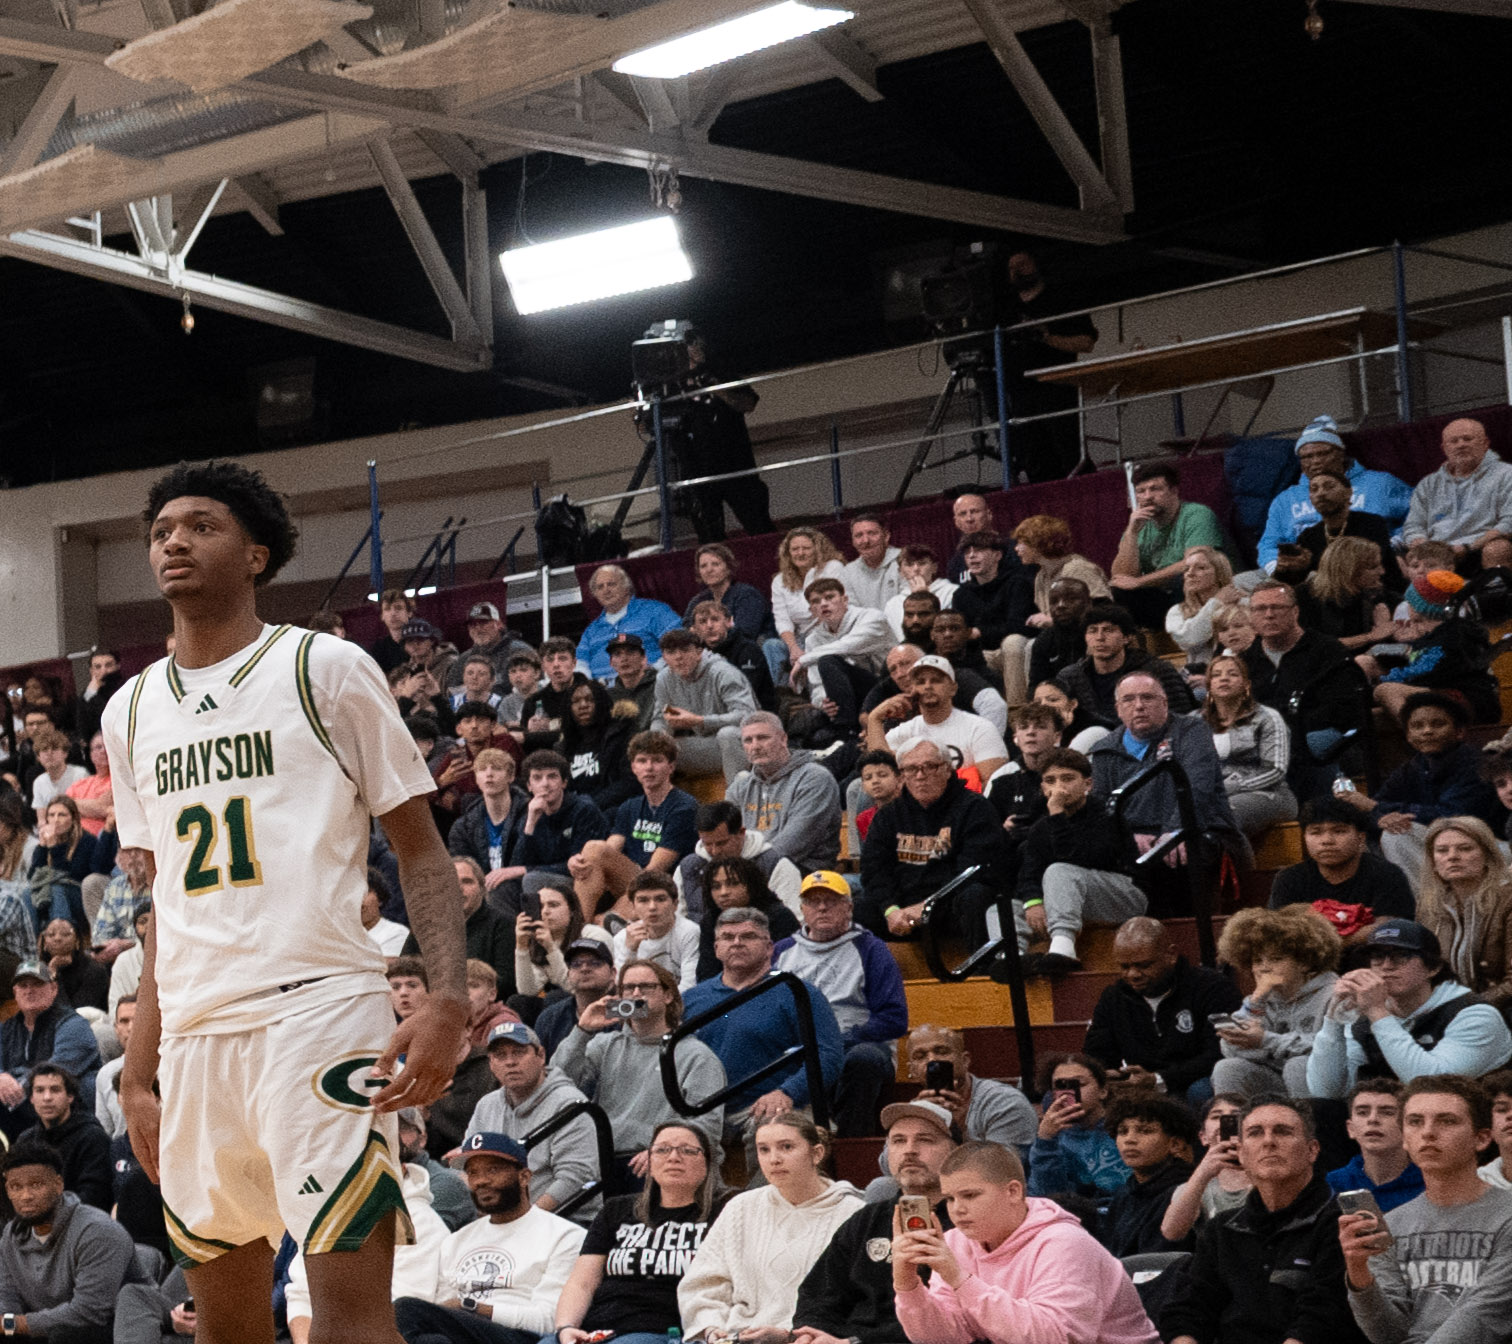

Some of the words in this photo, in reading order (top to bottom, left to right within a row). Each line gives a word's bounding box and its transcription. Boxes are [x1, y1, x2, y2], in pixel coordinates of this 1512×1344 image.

[155, 730, 275, 796] GRAYSON
[175, 795, 264, 897] 21
[471, 1134, 483, 1150] C
[606, 1247, 635, 1276] THE
[640, 1246, 697, 1276] PAIN
